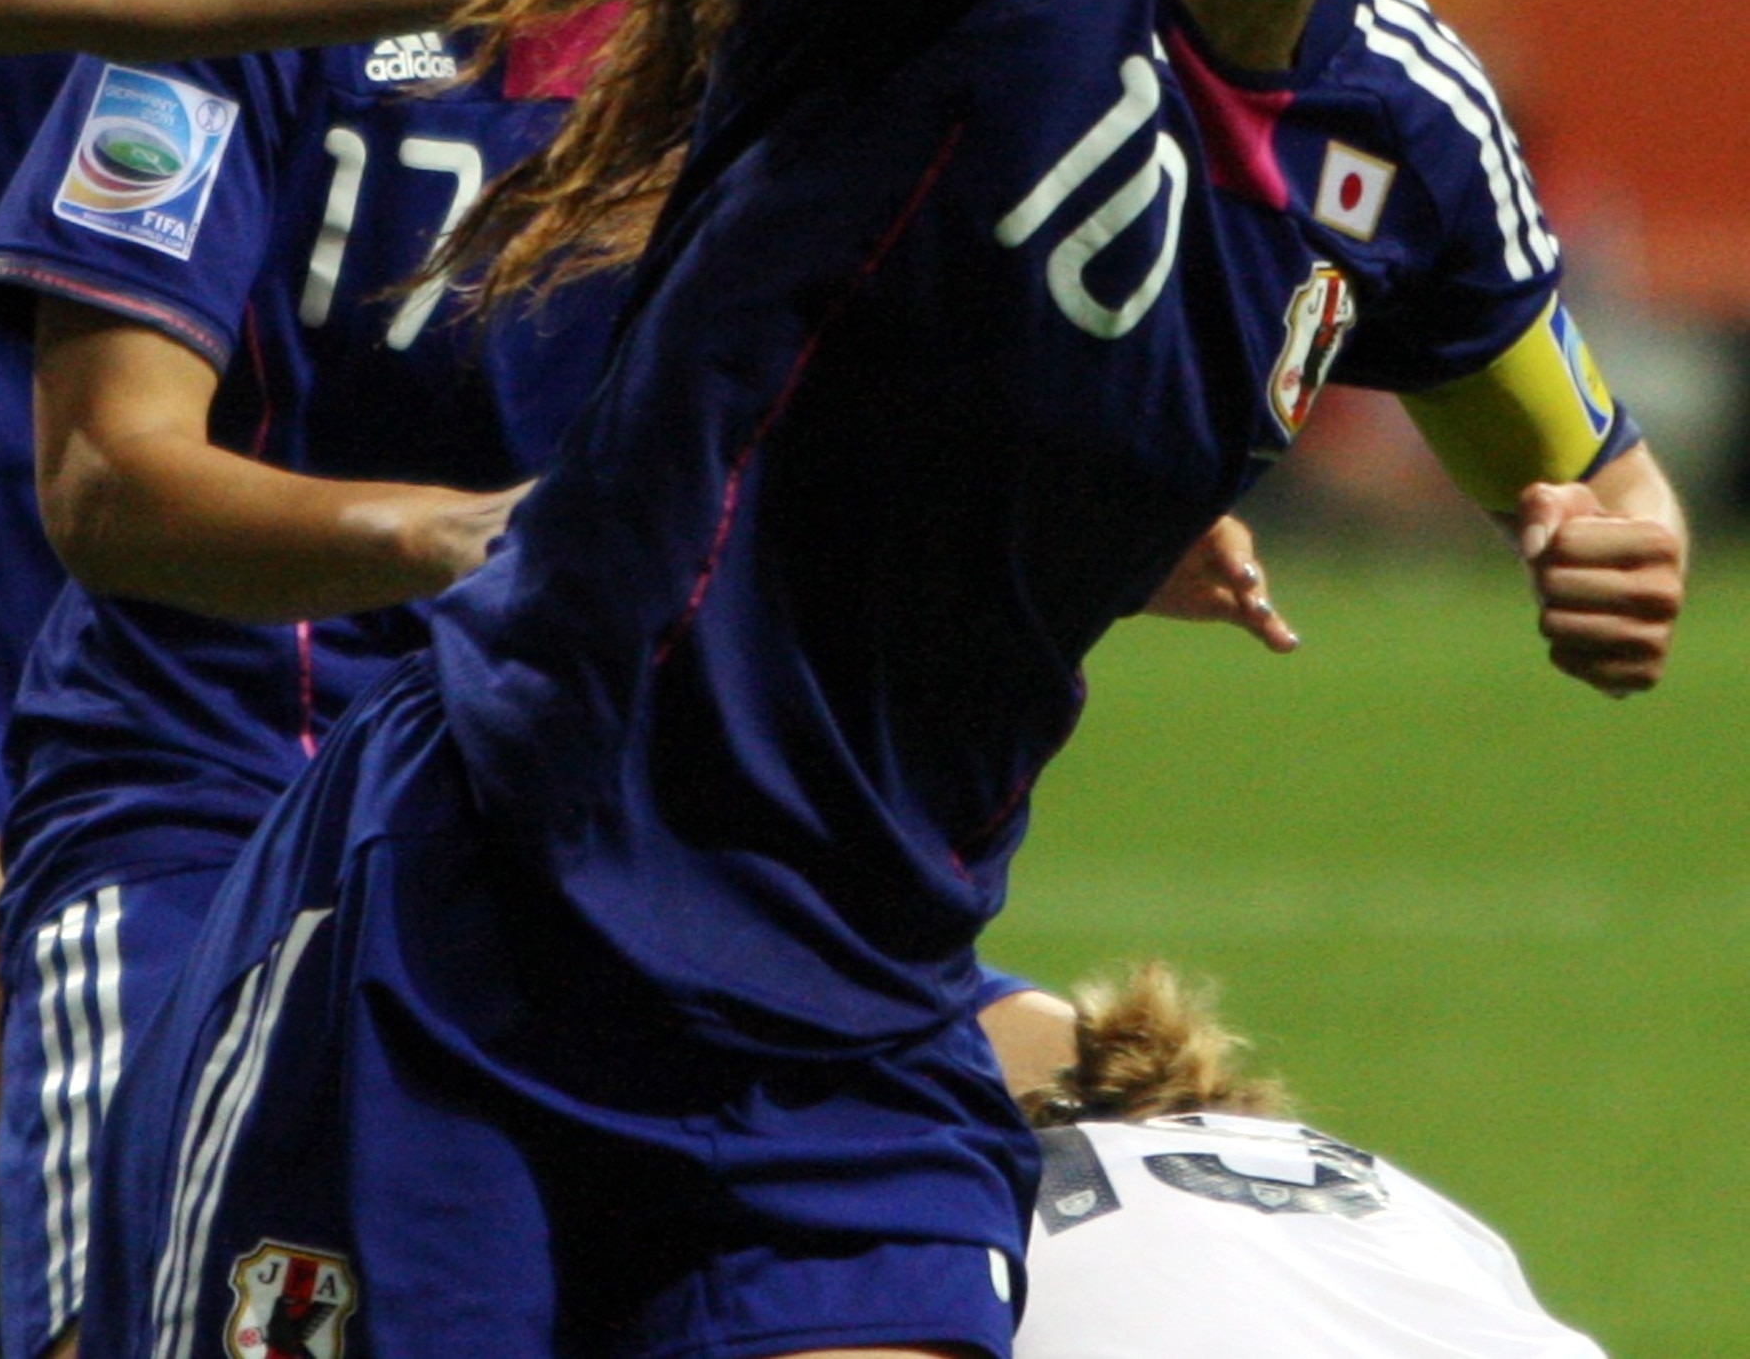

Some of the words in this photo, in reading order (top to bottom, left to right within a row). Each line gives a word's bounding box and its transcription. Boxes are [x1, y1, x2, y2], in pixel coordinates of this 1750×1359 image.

[365, 51, 457, 82] adidas
[141, 210, 186, 241] FIFA
[297, 127, 483, 352] 17
[994, 54, 1188, 340] 10
